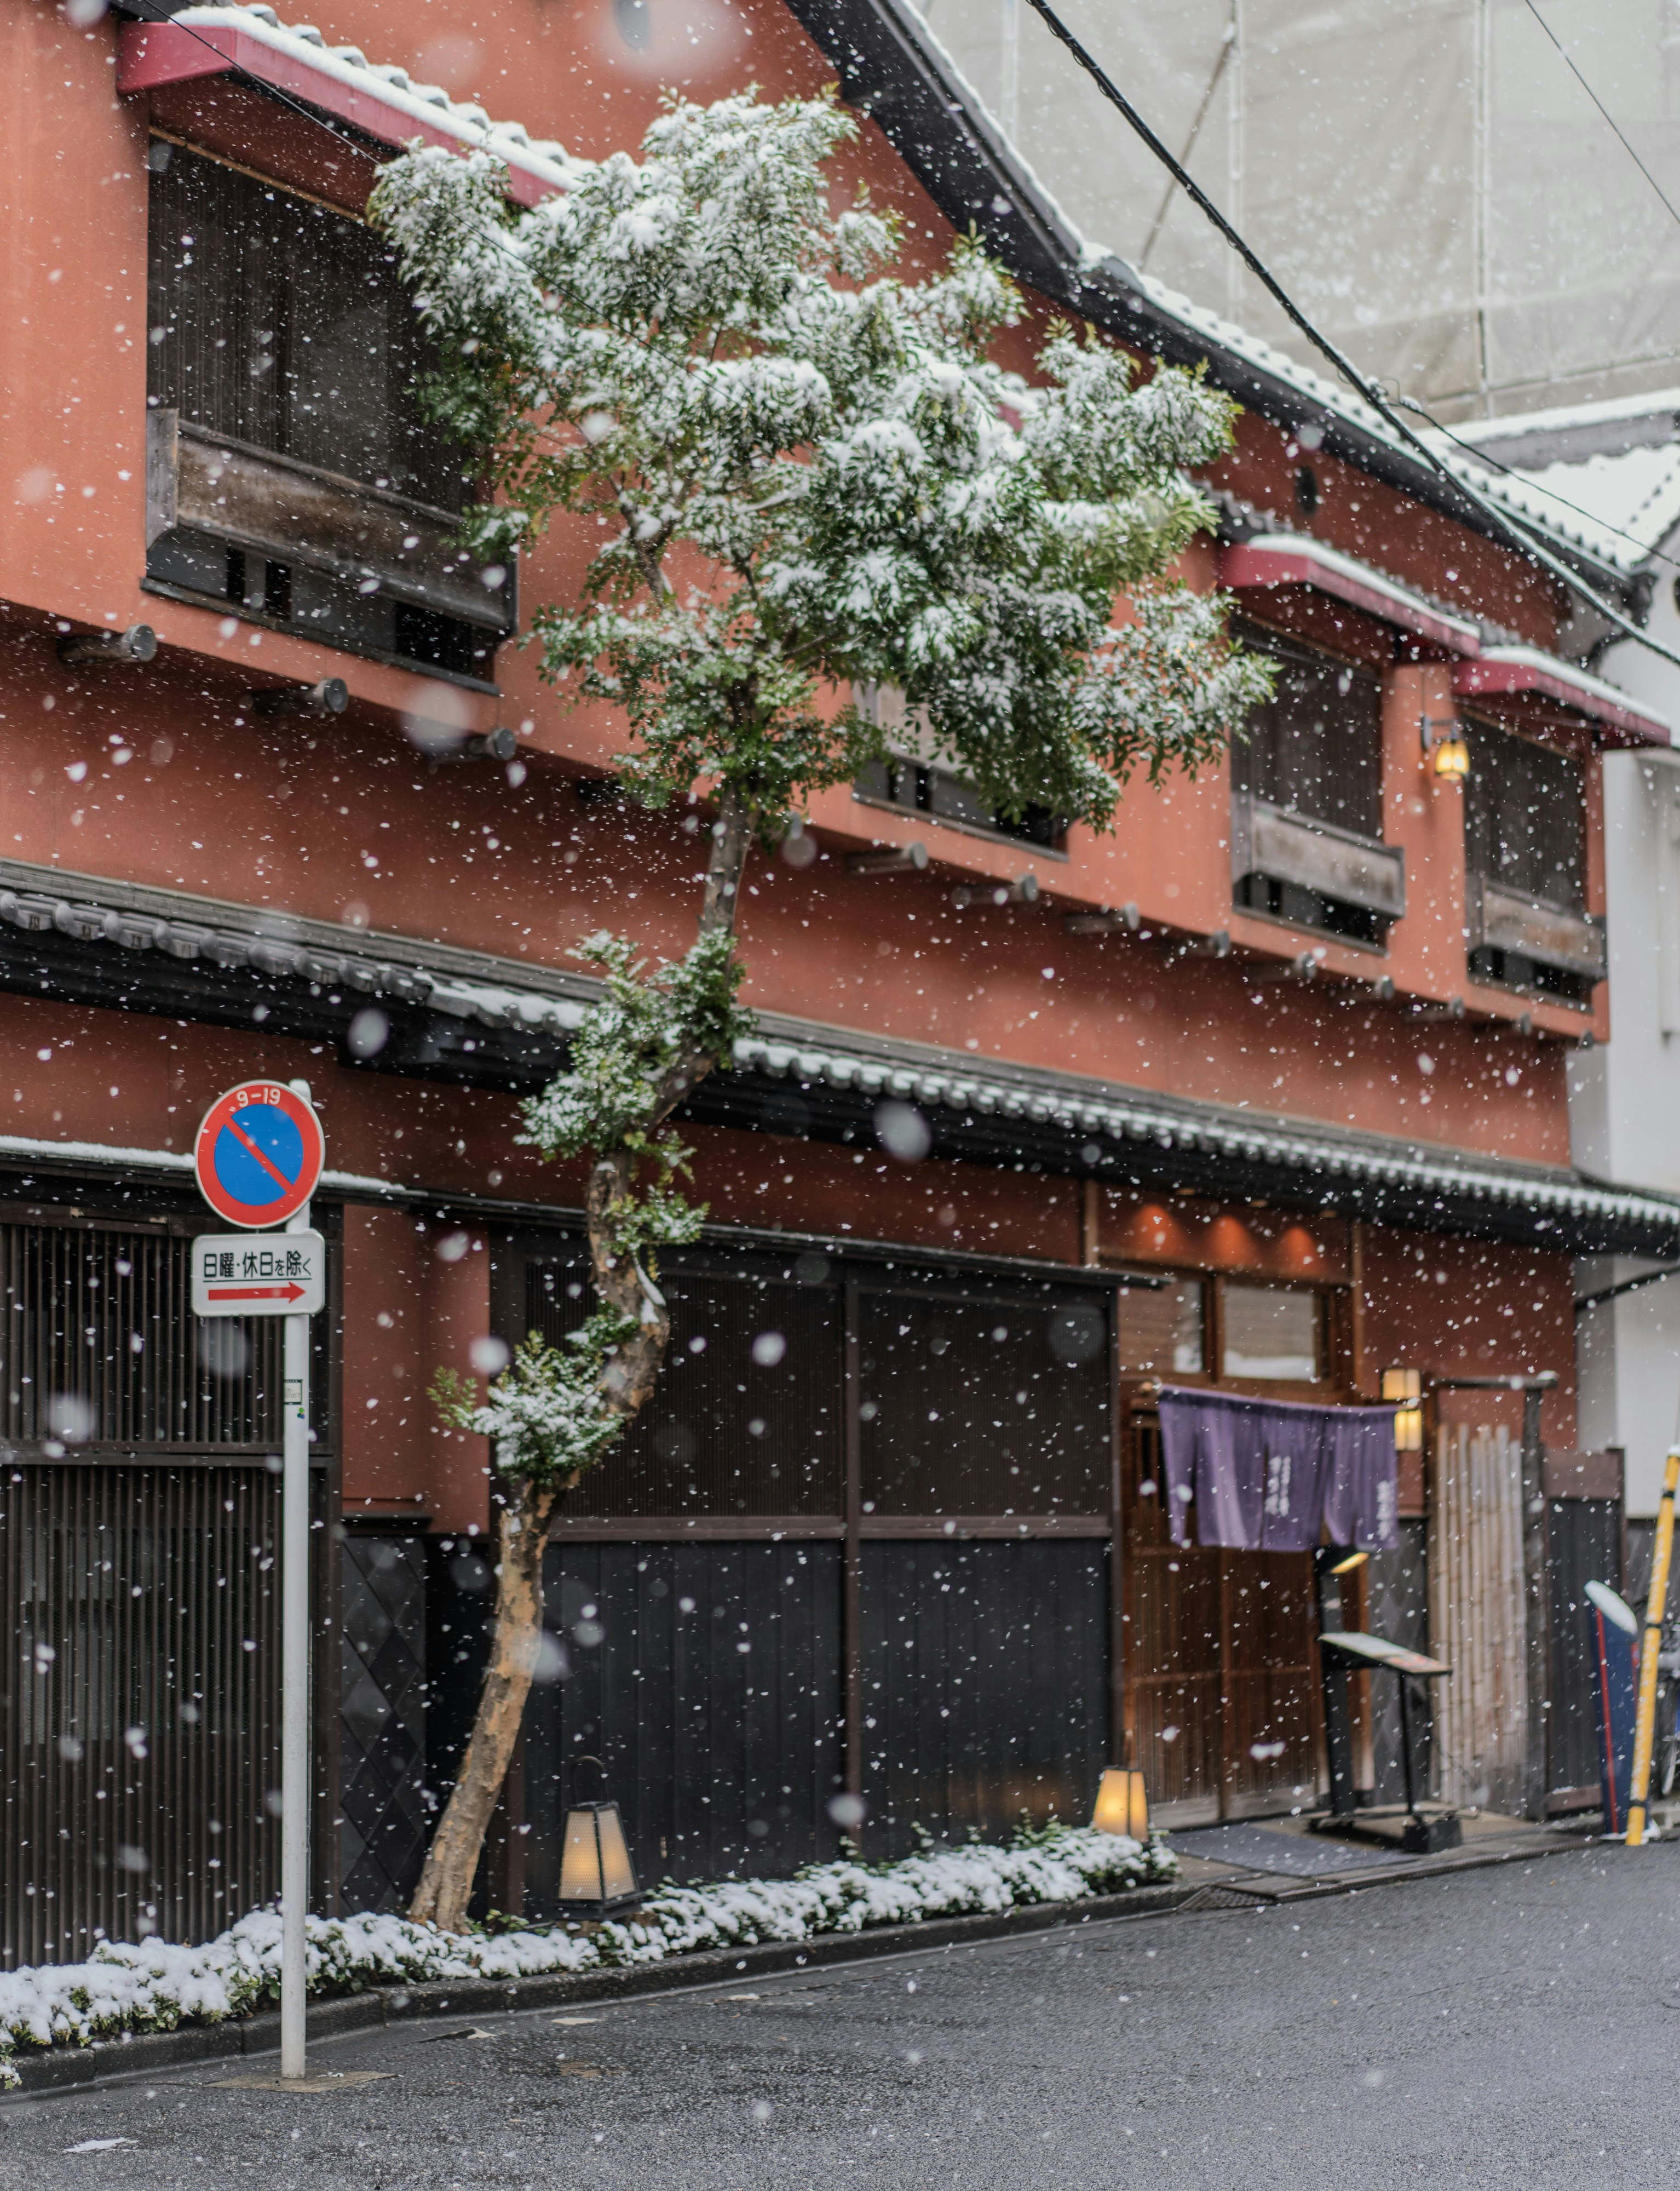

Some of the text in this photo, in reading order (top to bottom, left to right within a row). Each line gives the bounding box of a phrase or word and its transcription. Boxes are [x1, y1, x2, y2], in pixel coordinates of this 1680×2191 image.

[236, 1087, 281, 1108] 9-19
[204, 1250, 312, 1278] 日曜・休日を除く
